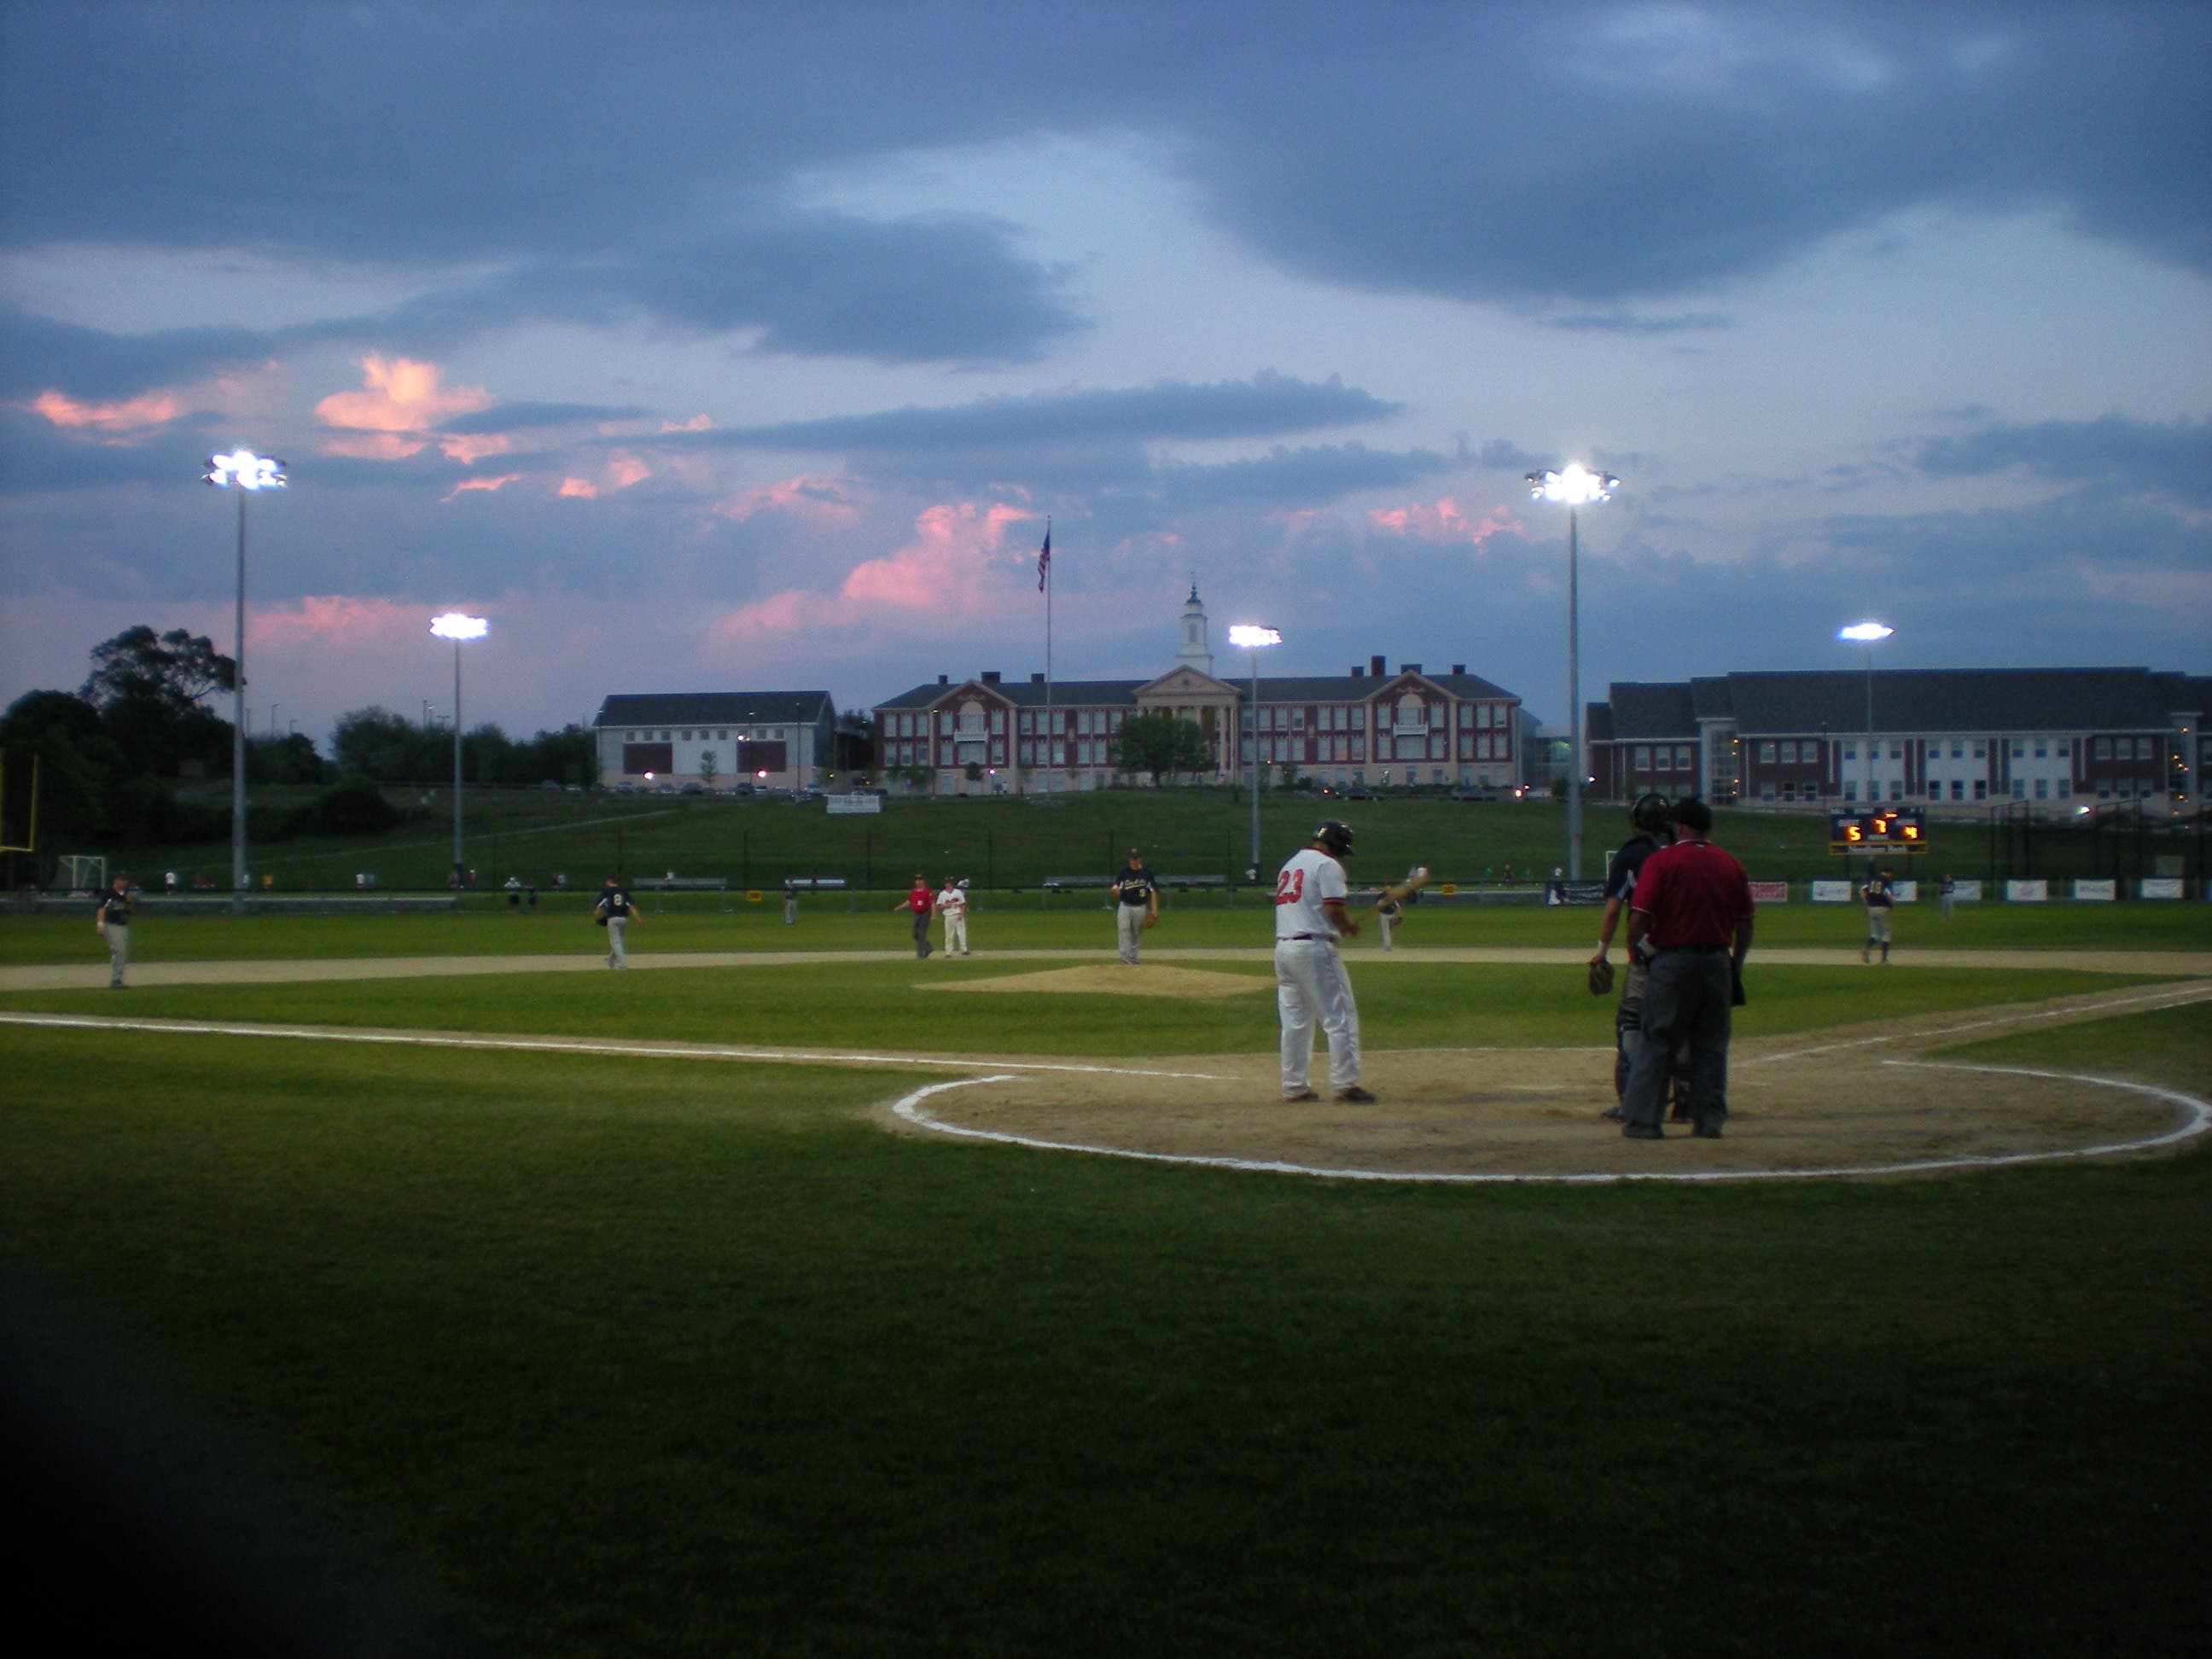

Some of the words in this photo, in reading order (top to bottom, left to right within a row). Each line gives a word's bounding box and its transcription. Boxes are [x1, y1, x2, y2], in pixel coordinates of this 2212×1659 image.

[1848, 825, 1862, 841] 5
[1276, 869, 1304, 905] 23
[614, 894, 622, 906] 8
